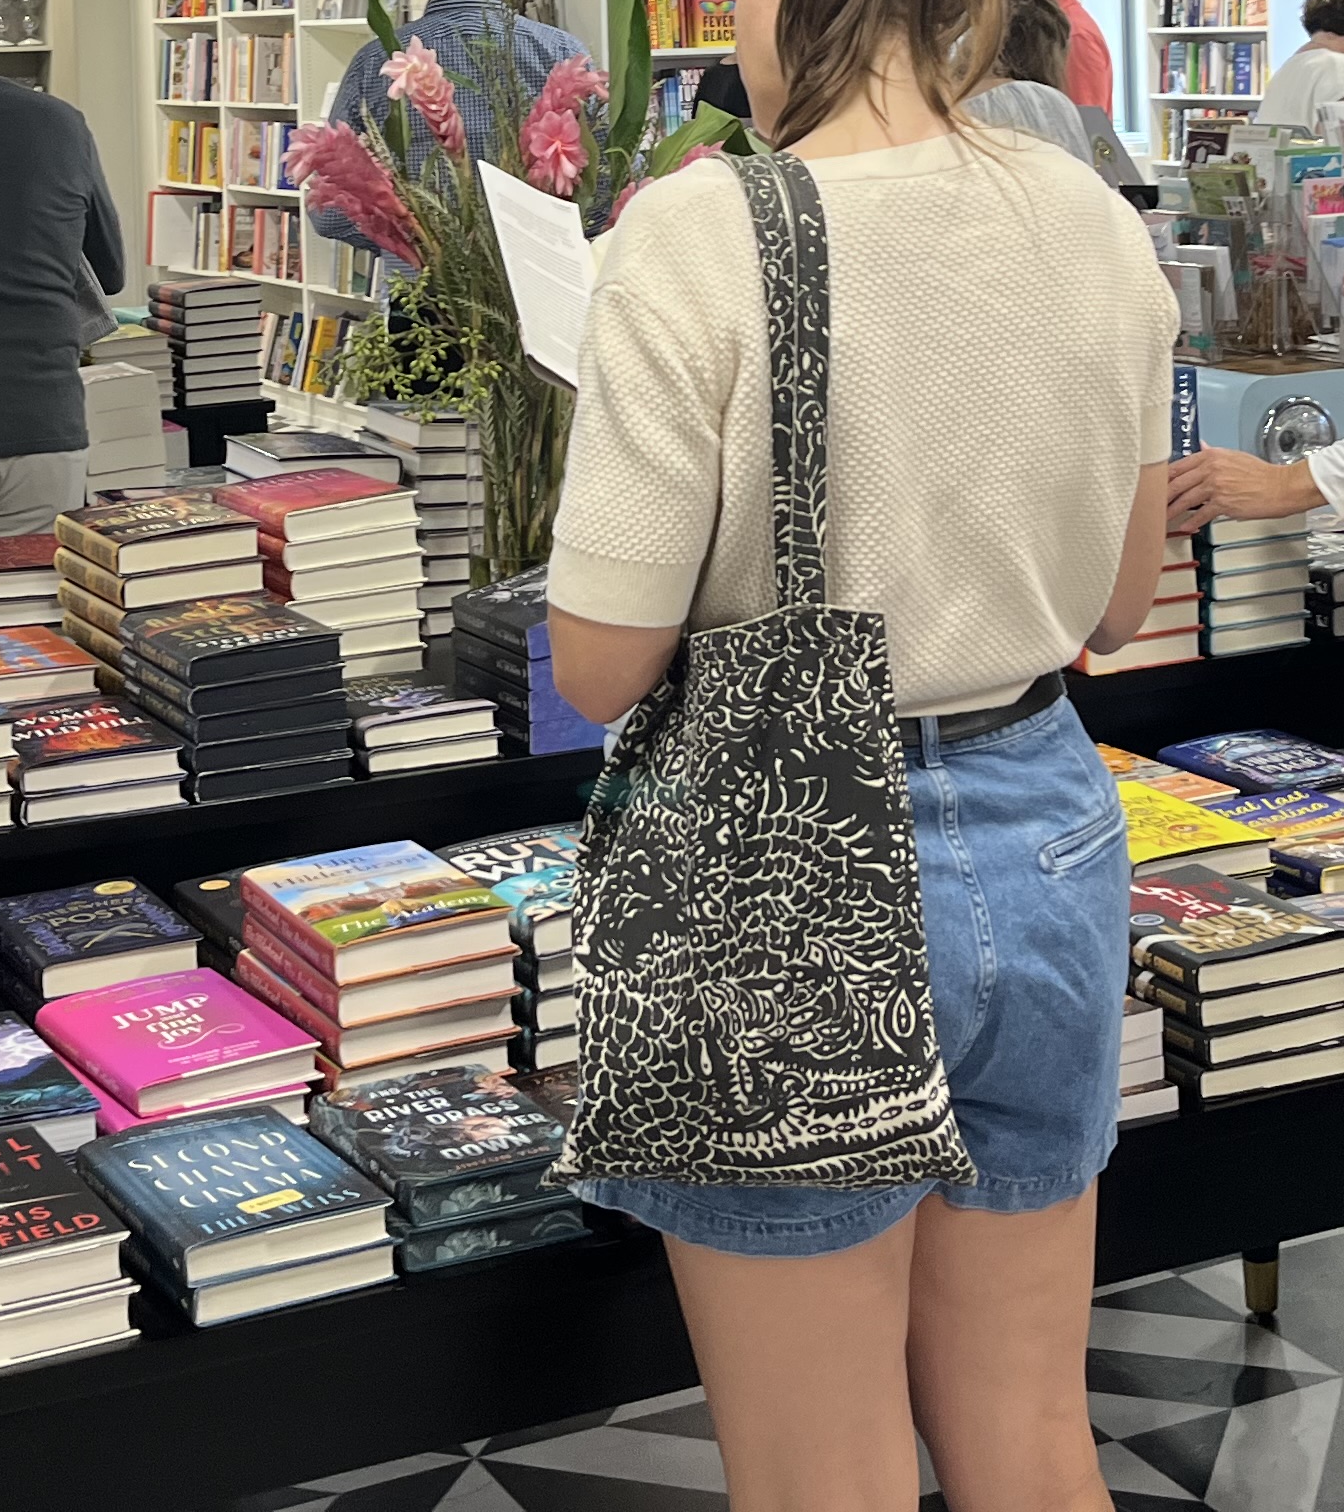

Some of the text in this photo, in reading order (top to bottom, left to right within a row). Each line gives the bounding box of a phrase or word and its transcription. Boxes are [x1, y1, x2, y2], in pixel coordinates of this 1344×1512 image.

[703, 15, 736, 28] FEVER
[11, 725, 81, 742] WILD
[87, 716, 145, 731] HILL
[13, 705, 120, 727] WOMEN
[1260, 789, 1311, 811] Last
[271, 852, 429, 890] Hilderbrand
[312, 854, 367, 871] Elin
[48, 904, 131, 928] POST
[339, 891, 492, 934] The Academy
[1158, 902, 1286, 935] LOUISE
[1175, 911, 1323, 955] ERDRICH
[112, 992, 210, 1030] JUMP
[368, 1087, 445, 1102] AND THE
[363, 1096, 452, 1124] RIVER
[424, 1099, 521, 1126] DRAGS
[499, 1112, 550, 1131] HER
[127, 1130, 288, 1174] SECOND
[439, 1131, 533, 1161] DOWN
[153, 1148, 305, 1192] CHANCE
[178, 1168, 324, 1209] CINEMA
[199, 1188, 362, 1236] THEA WEISS
